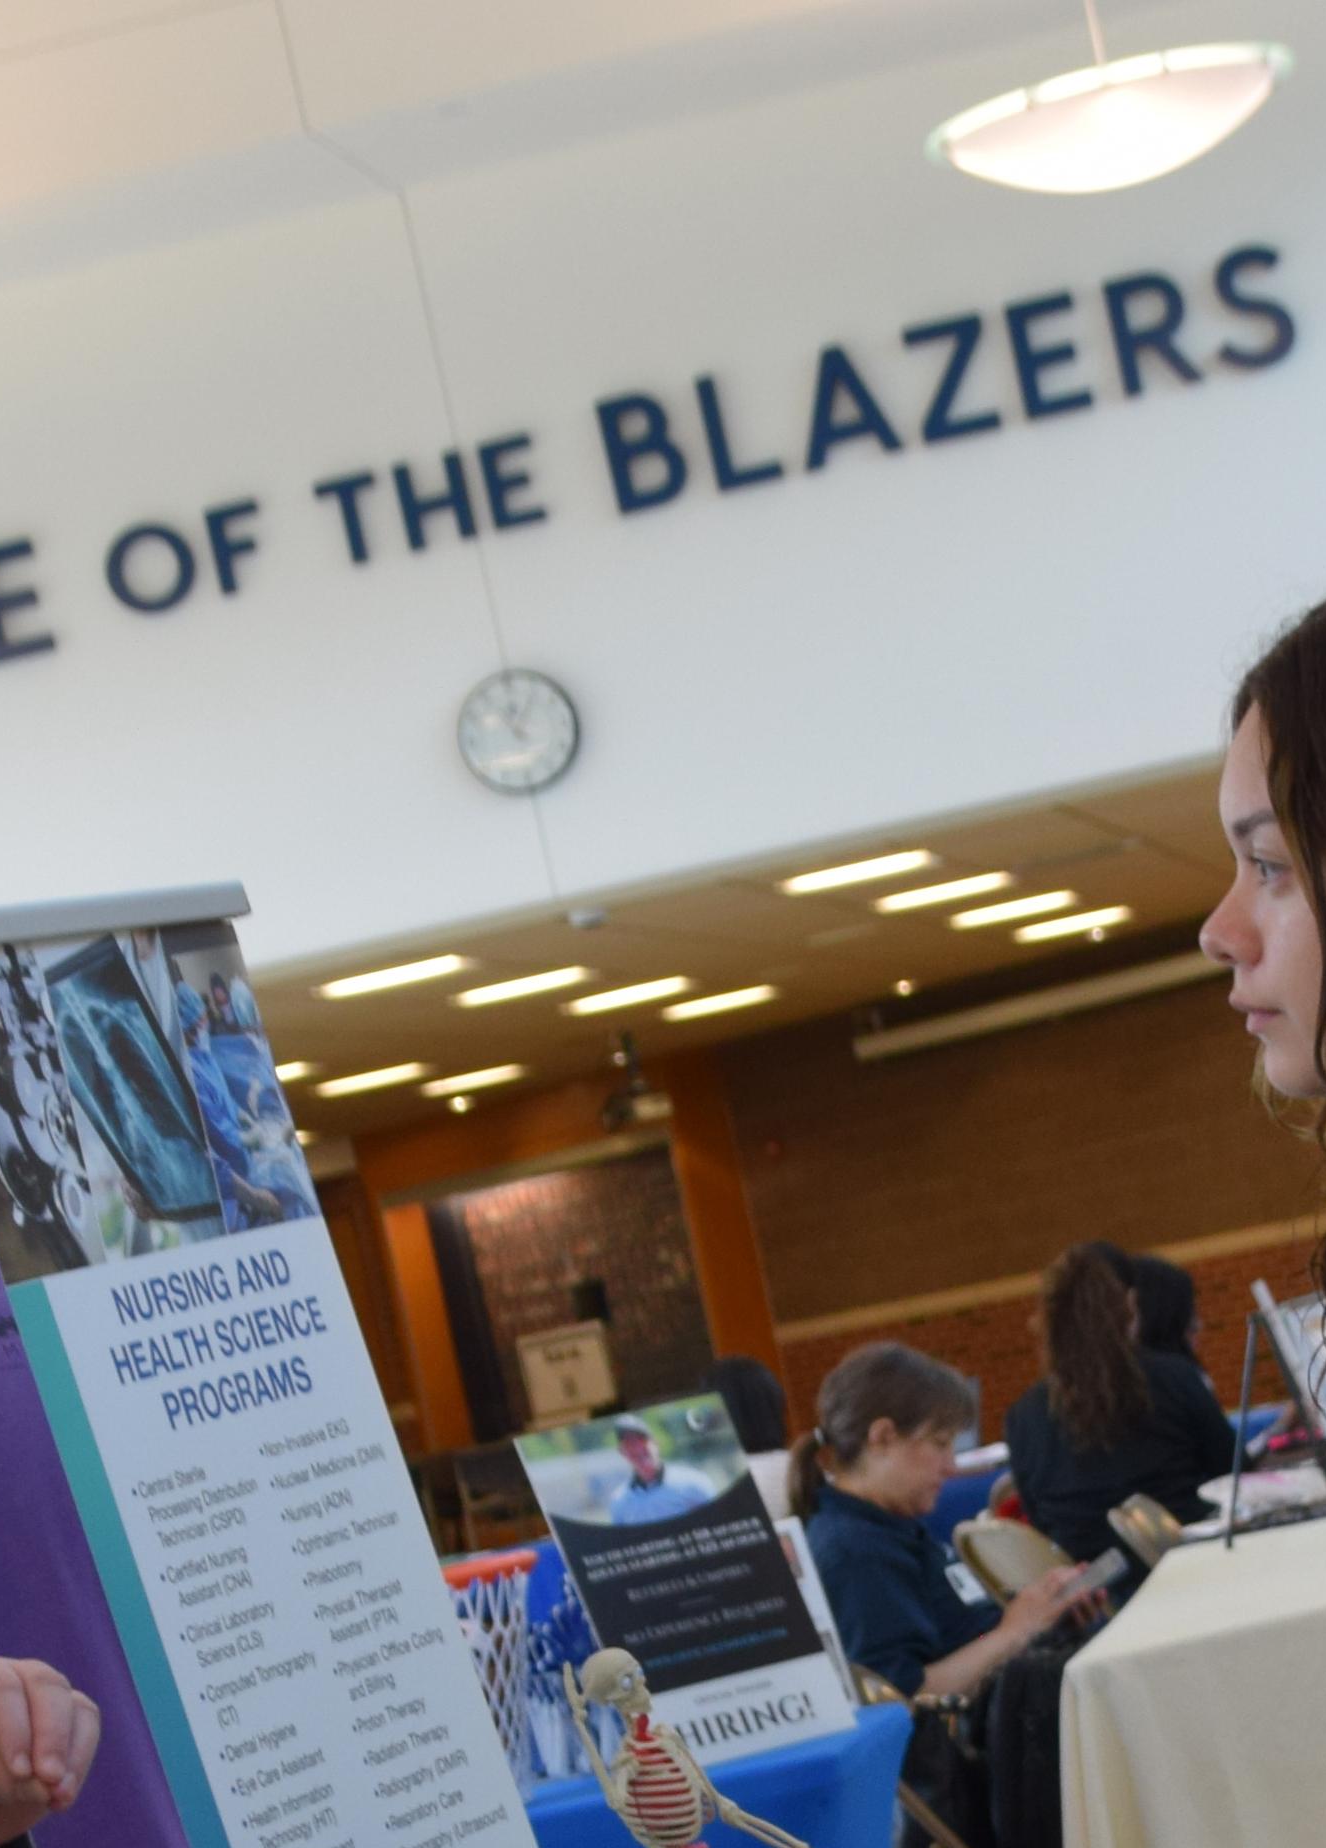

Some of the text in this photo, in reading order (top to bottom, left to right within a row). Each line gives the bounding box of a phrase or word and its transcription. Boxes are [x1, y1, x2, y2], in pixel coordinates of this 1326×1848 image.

[105, 499, 258, 613] OF
[314, 432, 547, 564] THE
[595, 245, 1295, 515] BLAZERS
[112, 1251, 289, 1324] NURSING AND
[111, 1297, 326, 1383] HEALTH SCIENCE
[163, 1357, 311, 1429] PROGRAMS
[138, 1467, 206, 1499] Central Sterile
[201, 1479, 258, 1507] Distribution
[284, 1502, 323, 1522] Nursing
[350, 1512, 399, 1536] Technician
[207, 1547, 247, 1568] Nursing
[179, 1581, 223, 1608] Assistant
[356, 1579, 403, 1606] Therapist
[186, 1603, 275, 1643] Clinical Laboratory
[329, 1617, 371, 1643] Assistant
[196, 1643, 237, 1668] Science
[337, 1628, 445, 1677] Physician Office Coding
[206, 1652, 316, 1703] Computed Tomography
[349, 1673, 396, 1702] and Billing
[385, 1698, 426, 1720] Therapy
[676, 1690, 816, 1750] HIRING!
[225, 1724, 297, 1762] Dental Hygiene
[367, 1726, 449, 1766] Radiation Therapy
[236, 1748, 325, 1796] Eye Care Assistant
[248, 1784, 333, 1829] Health Information
[389, 1790, 463, 1831] Respiratory Care
